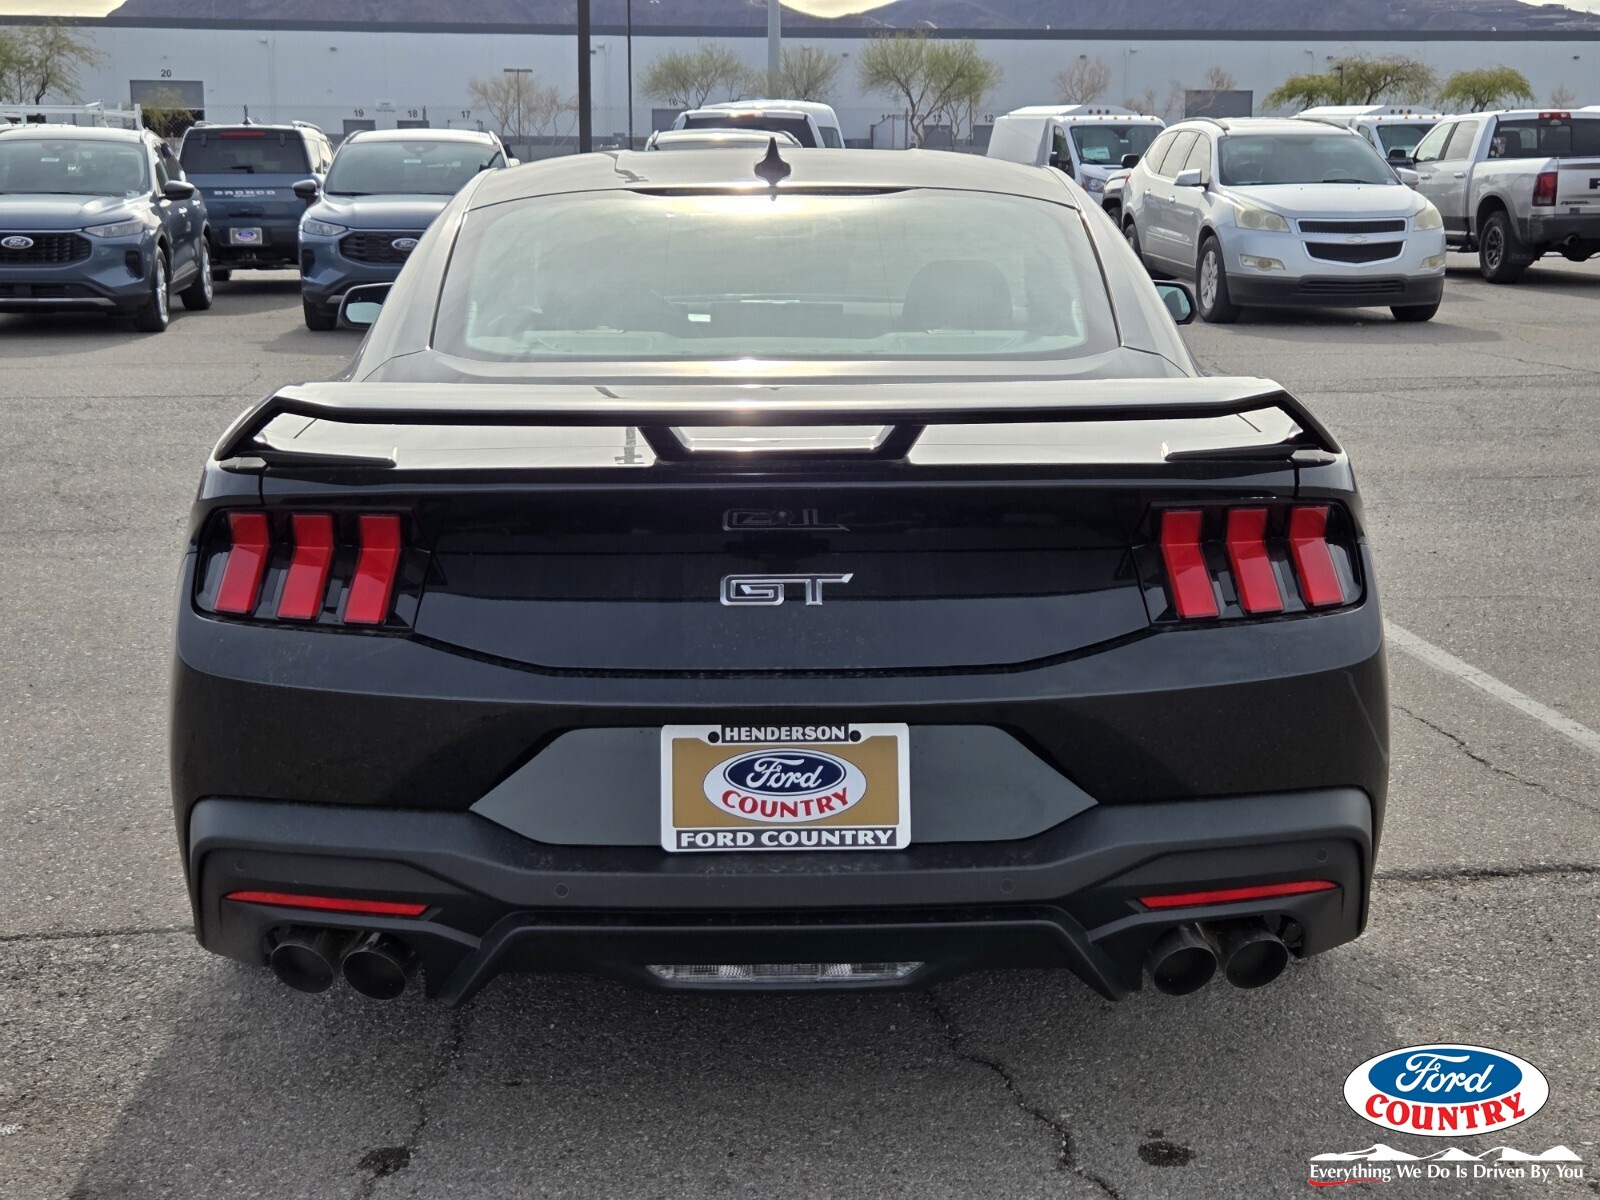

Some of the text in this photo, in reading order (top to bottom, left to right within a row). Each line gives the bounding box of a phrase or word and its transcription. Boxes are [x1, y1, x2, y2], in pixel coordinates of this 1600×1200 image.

[160, 68, 172, 78] 20
[353, 109, 364, 118] 19
[407, 109, 418, 118] 18
[461, 110, 471, 119] 17
[984, 114, 994, 122] 12
[720, 572, 854, 606] GT
[724, 725, 846, 742] HENDERSON
[746, 757, 824, 789] Ford
[721, 787, 849, 818] COUNTRY
[680, 829, 894, 847] FORD COUNTRY
